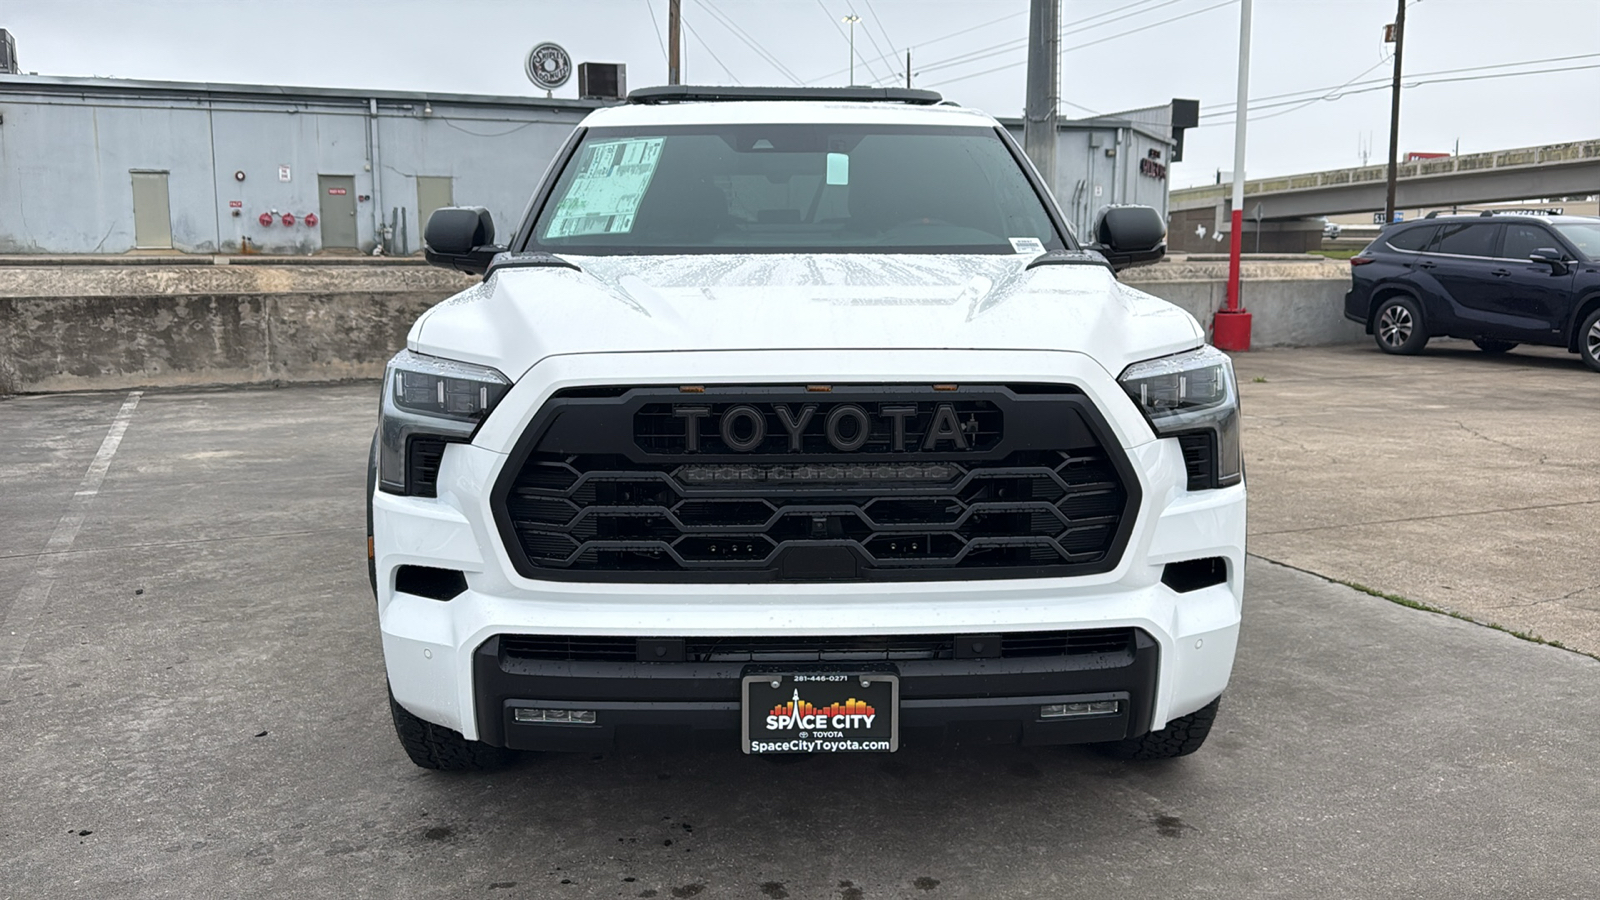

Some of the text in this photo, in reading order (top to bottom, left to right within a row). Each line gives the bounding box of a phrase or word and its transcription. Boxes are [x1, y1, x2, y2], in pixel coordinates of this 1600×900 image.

[672, 403, 969, 451] TOYOTA
[766, 714, 875, 730] SPACE CITY
[751, 740, 890, 753] SpaceCityToyota.com
